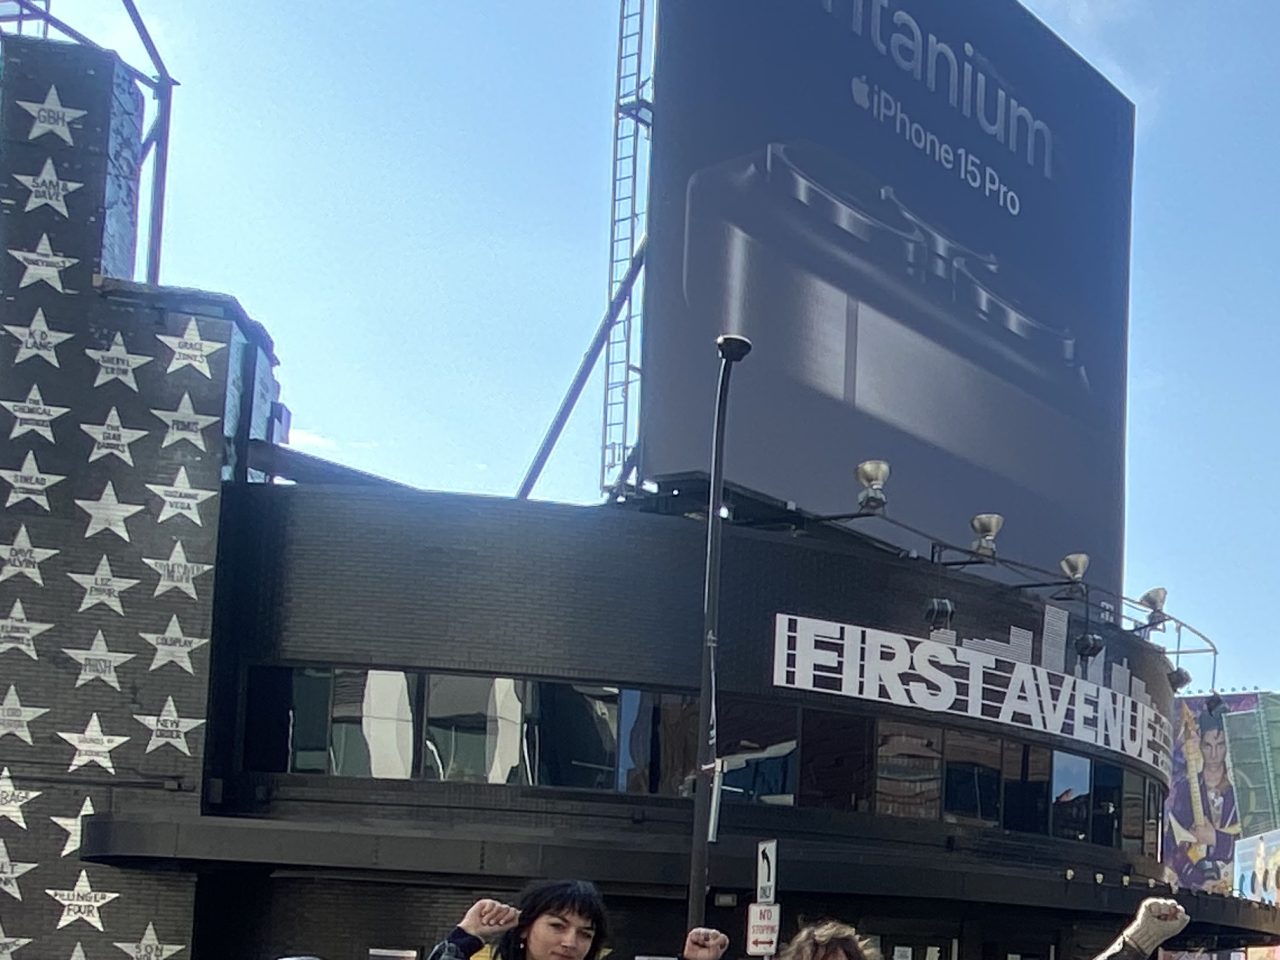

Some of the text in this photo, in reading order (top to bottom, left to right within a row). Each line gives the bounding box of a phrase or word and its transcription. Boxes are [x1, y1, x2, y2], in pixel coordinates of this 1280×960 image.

[37, 108, 66, 126] GBH
[822, 0, 1052, 180] itanium
[873, 85, 1020, 215] iPhone 15 Pro
[797, 614, 996, 719] FIRST
[66, 904, 95, 917] FOUR
[759, 909, 772, 921] NO
